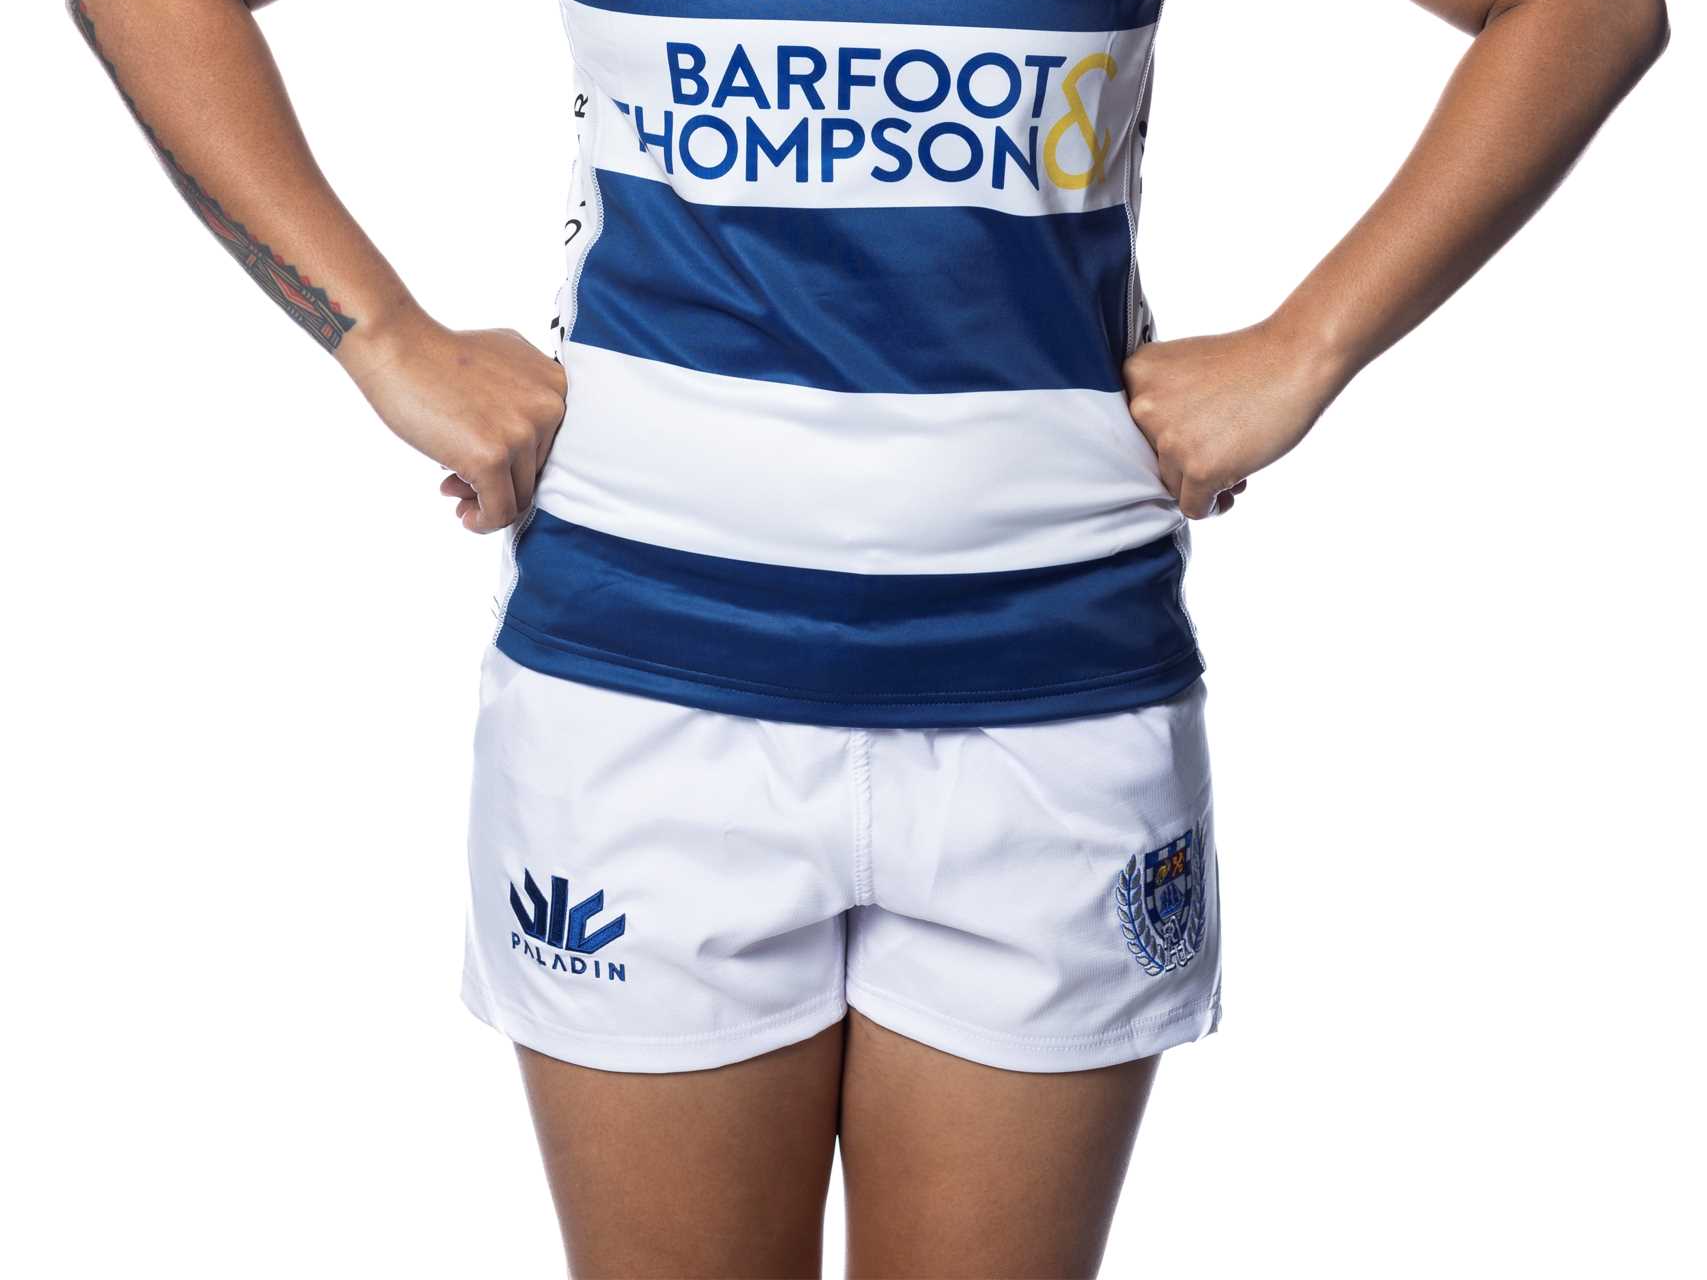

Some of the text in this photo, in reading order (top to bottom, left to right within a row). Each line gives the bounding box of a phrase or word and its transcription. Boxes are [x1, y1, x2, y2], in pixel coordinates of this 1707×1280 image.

[666, 41, 1067, 119] BARFOOT
[1043, 52, 1118, 190] &
[511, 931, 626, 982] PALADIN
